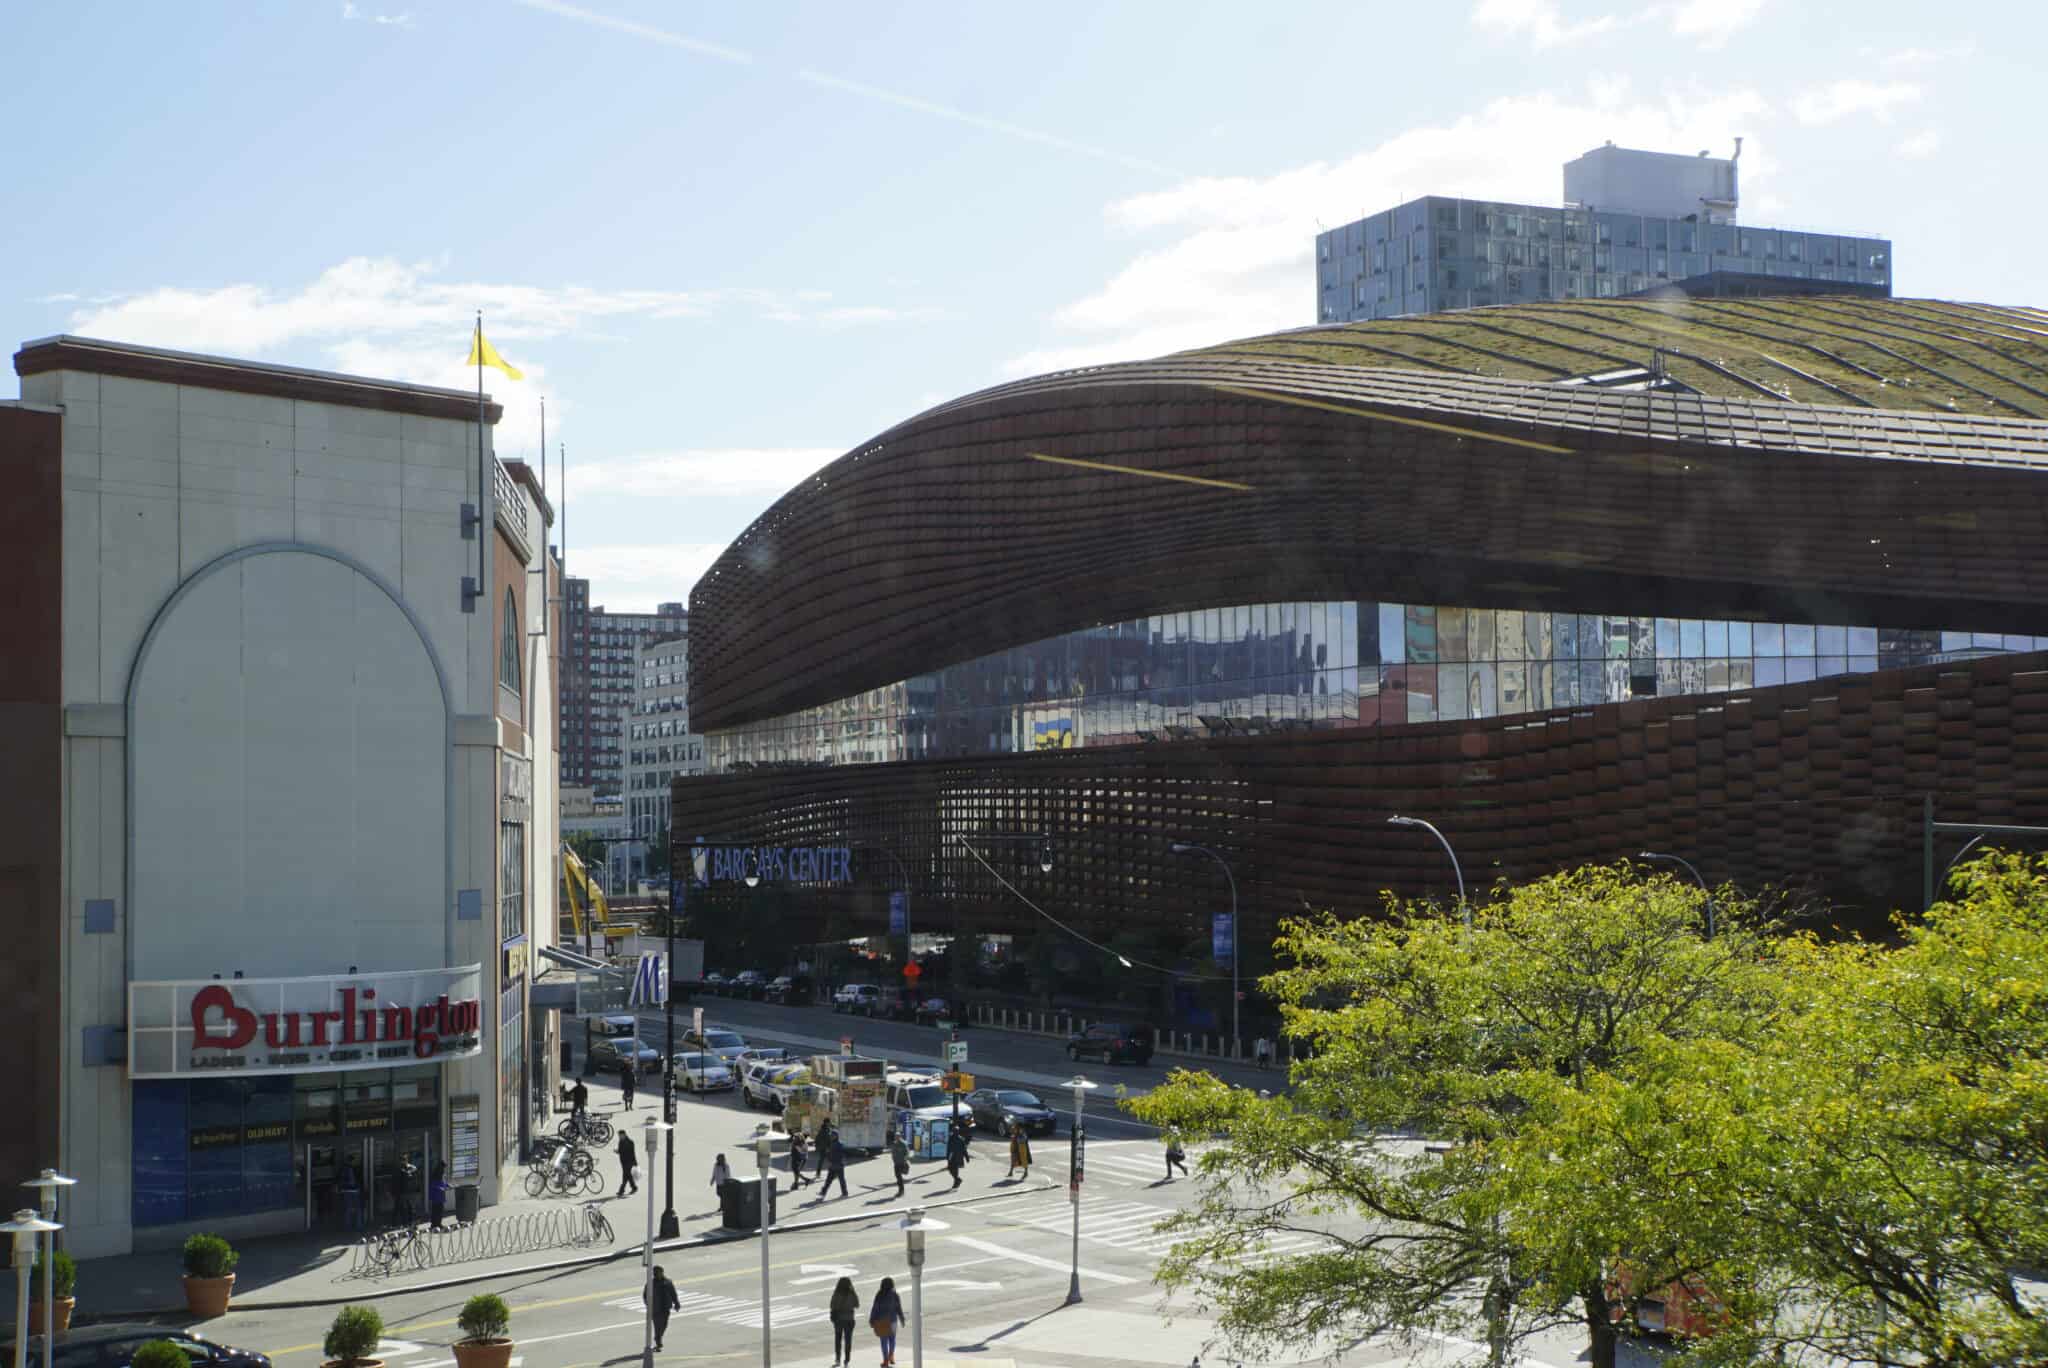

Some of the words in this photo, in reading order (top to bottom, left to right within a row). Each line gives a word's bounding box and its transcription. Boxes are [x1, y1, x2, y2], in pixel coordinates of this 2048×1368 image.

[713, 848, 785, 880] BARCAYS
[789, 848, 853, 881] CENTER
[191, 985, 480, 1058] Burlington
[247, 1128, 264, 1138] OLD
